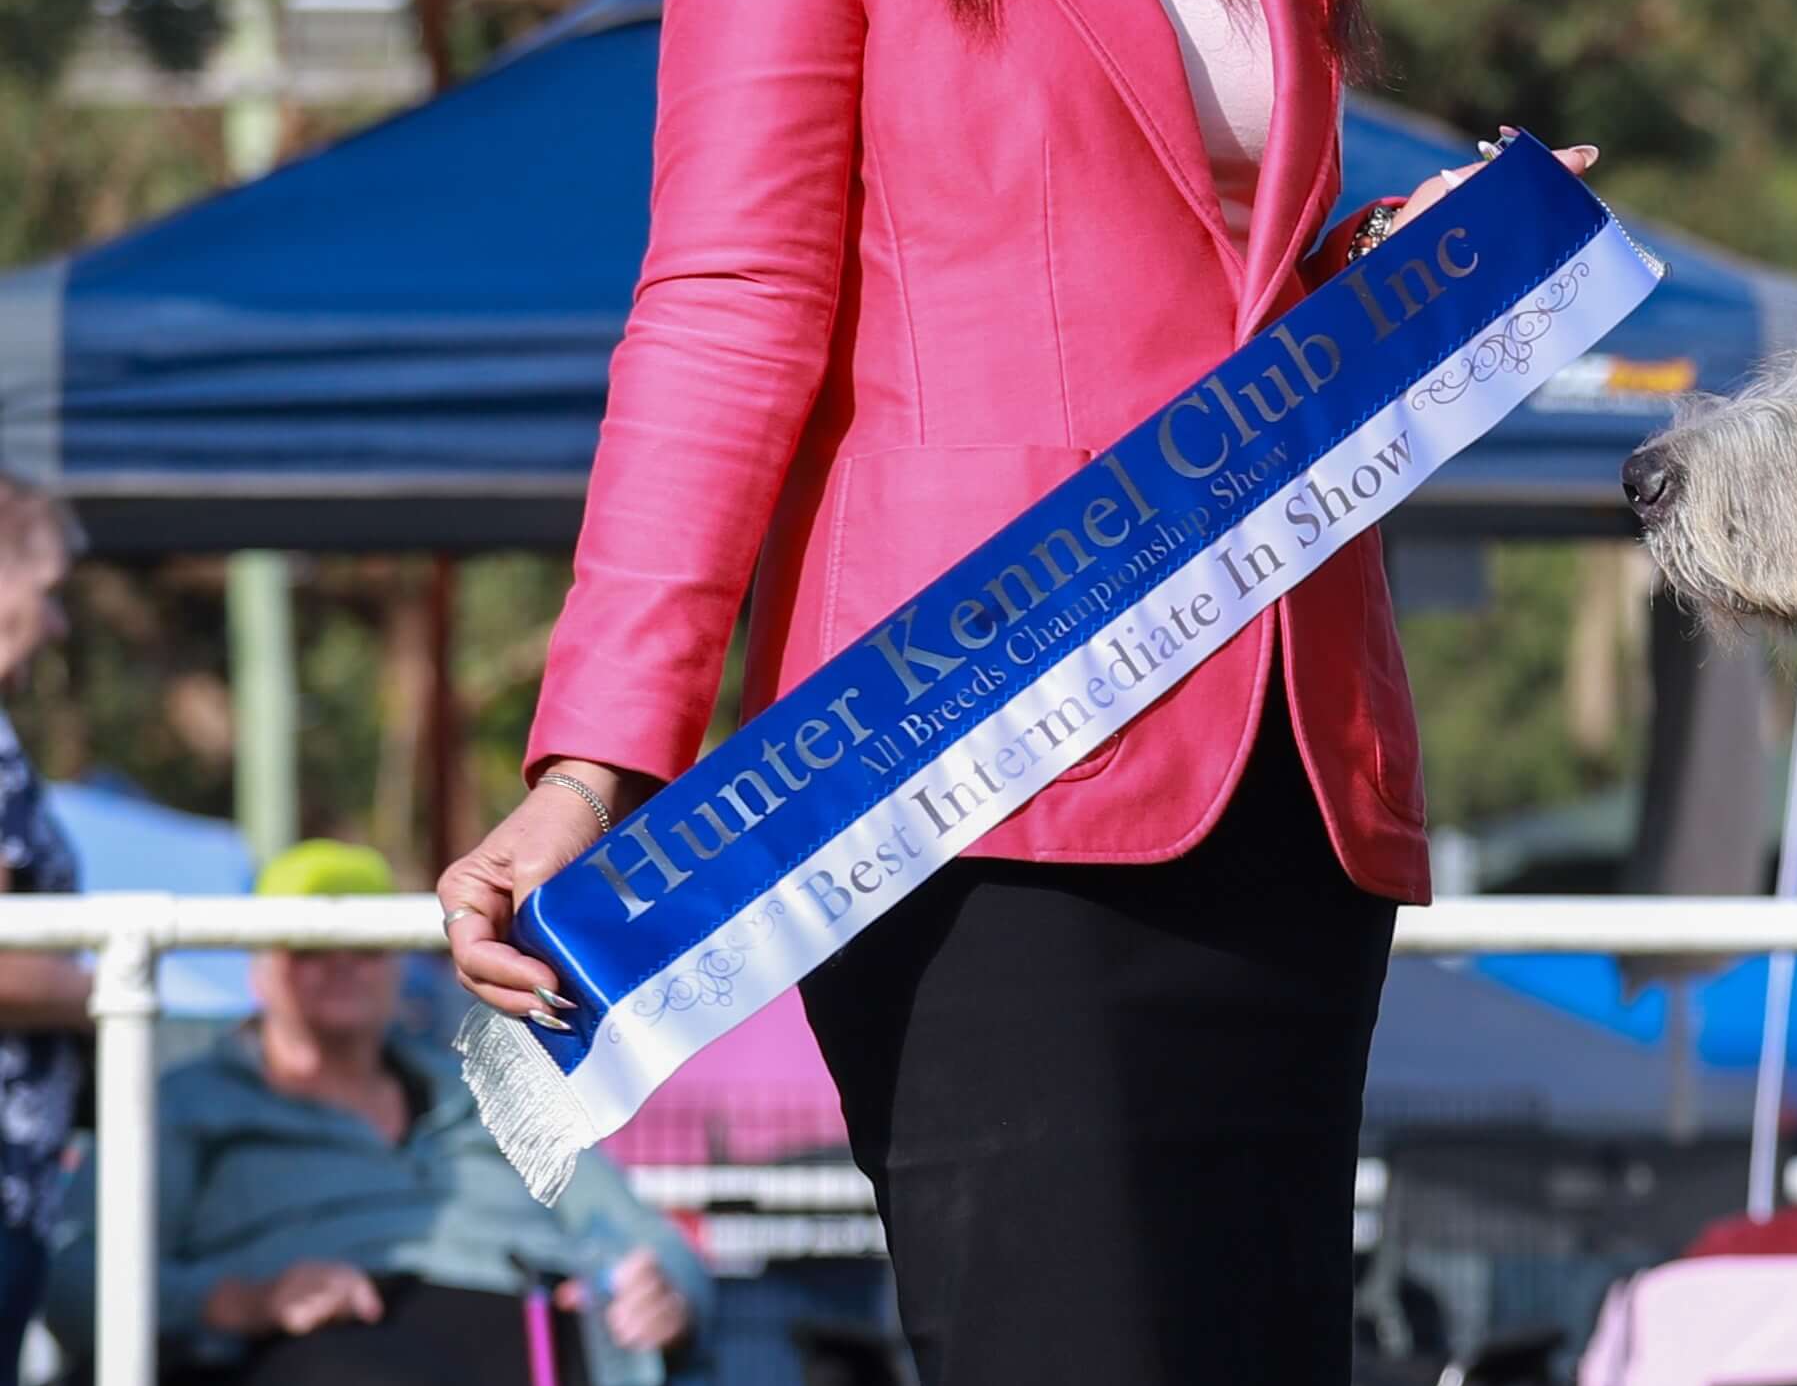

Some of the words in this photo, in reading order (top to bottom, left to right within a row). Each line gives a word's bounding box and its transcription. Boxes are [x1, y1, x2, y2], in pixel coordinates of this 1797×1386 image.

[584, 687, 874, 923] Hunter
[865, 453, 1159, 705] Kennel
[1157, 323, 1341, 479] Club
[1341, 227, 1479, 343] Inc
[797, 821, 922, 928] Best
[909, 590, 1221, 839] Intermediate
[1216, 542, 1286, 599] In
[1285, 430, 1414, 549] Show
[858, 735, 905, 776] All
[899, 663, 1007, 748] Breeds
[1005, 506, 1209, 665] Championship
[1210, 441, 1290, 510] Show
